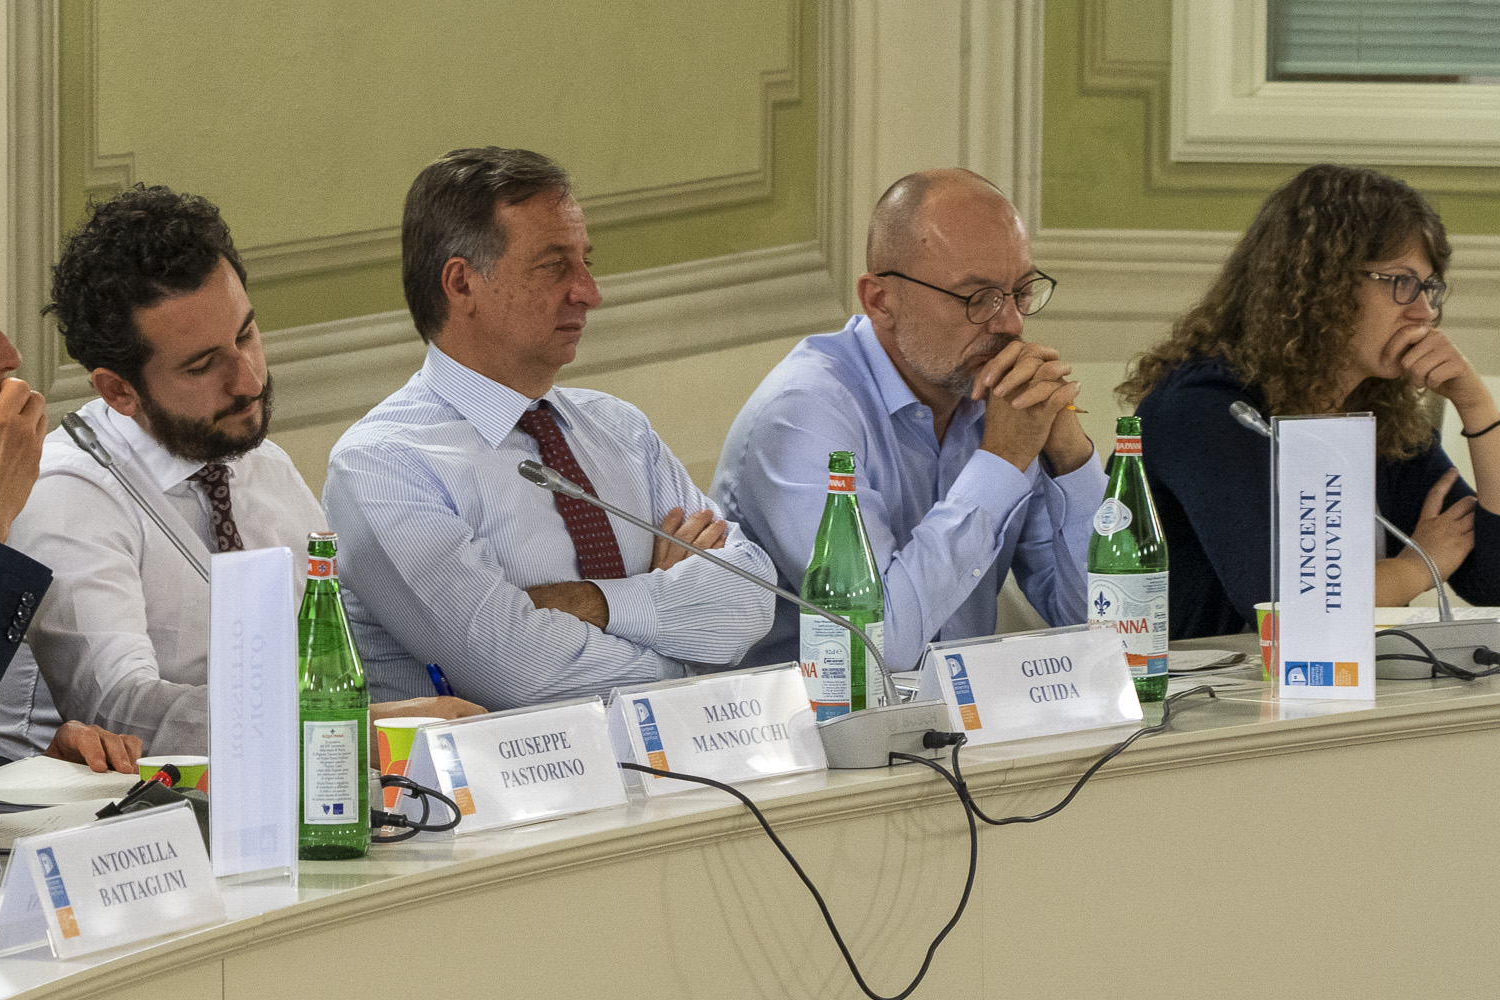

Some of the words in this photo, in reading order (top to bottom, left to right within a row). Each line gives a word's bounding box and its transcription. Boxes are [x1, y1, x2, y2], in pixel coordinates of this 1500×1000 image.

[1299, 490, 1317, 595] VINCENT
[1325, 473, 1342, 613] THOUVENIN
[1021, 655, 1073, 678] GUIDO
[1029, 682, 1081, 704] GUIDA
[703, 698, 762, 723] MARCO
[498, 731, 571, 759] GIUSEPPE
[692, 723, 790, 753] MANNOCCHI
[500, 758, 585, 788] PASTORINO
[91, 840, 178, 877] ANTONELLA
[99, 869, 188, 907] BATTAGLINI
